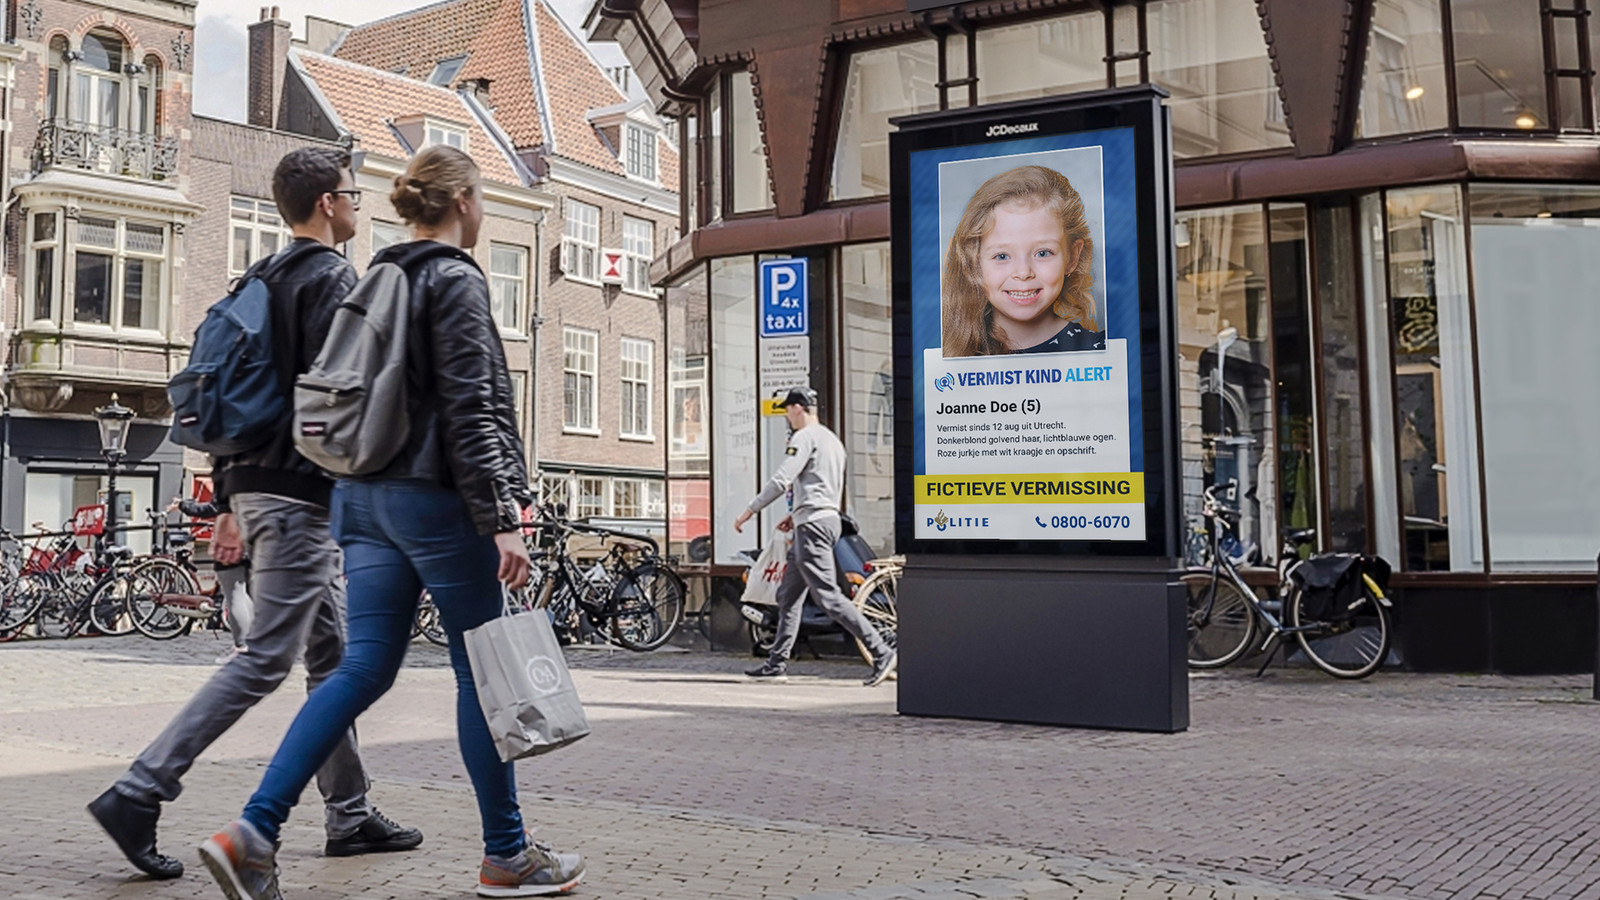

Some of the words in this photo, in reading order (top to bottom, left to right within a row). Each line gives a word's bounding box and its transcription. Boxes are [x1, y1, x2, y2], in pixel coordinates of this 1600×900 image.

[985, 122, 1039, 137] JCDecaux
[771, 267, 798, 306] P
[780, 296, 800, 309] 4x
[766, 311, 803, 331] taxi
[957, 370, 1023, 387] VERMIST
[1025, 368, 1062, 384] KIND
[1065, 366, 1113, 383] ALERT
[936, 402, 987, 415] Joanne
[990, 400, 1018, 413] Doe
[1021, 398, 1041, 416] (5)
[937, 423, 967, 433] Vermist
[969, 423, 990, 432] sinds
[993, 422, 1002, 431] 12
[1004, 423, 1019, 433] aug
[1021, 421, 1032, 431] uit
[1034, 420, 1067, 430] Utrecht.
[937, 435, 987, 445] Donkerblond
[988, 434, 1020, 446] golvend
[1021, 434, 1041, 444] haar,
[1043, 433, 1091, 443] lichtblauwe
[1093, 434, 1117, 444] ogen.
[937, 449, 957, 458] Roze
[958, 448, 980, 459] jurkje
[981, 448, 998, 457] met
[999, 448, 1012, 457] wit
[1013, 447, 1043, 458] kraagje
[1044, 448, 1056, 456] en
[1057, 445, 1097, 457] opschrift.
[926, 481, 1007, 497] FICTIEVE
[1010, 480, 1131, 496] VERMISSING
[926, 515, 990, 532] POLITIE
[1050, 515, 1131, 529] 0800-6070
